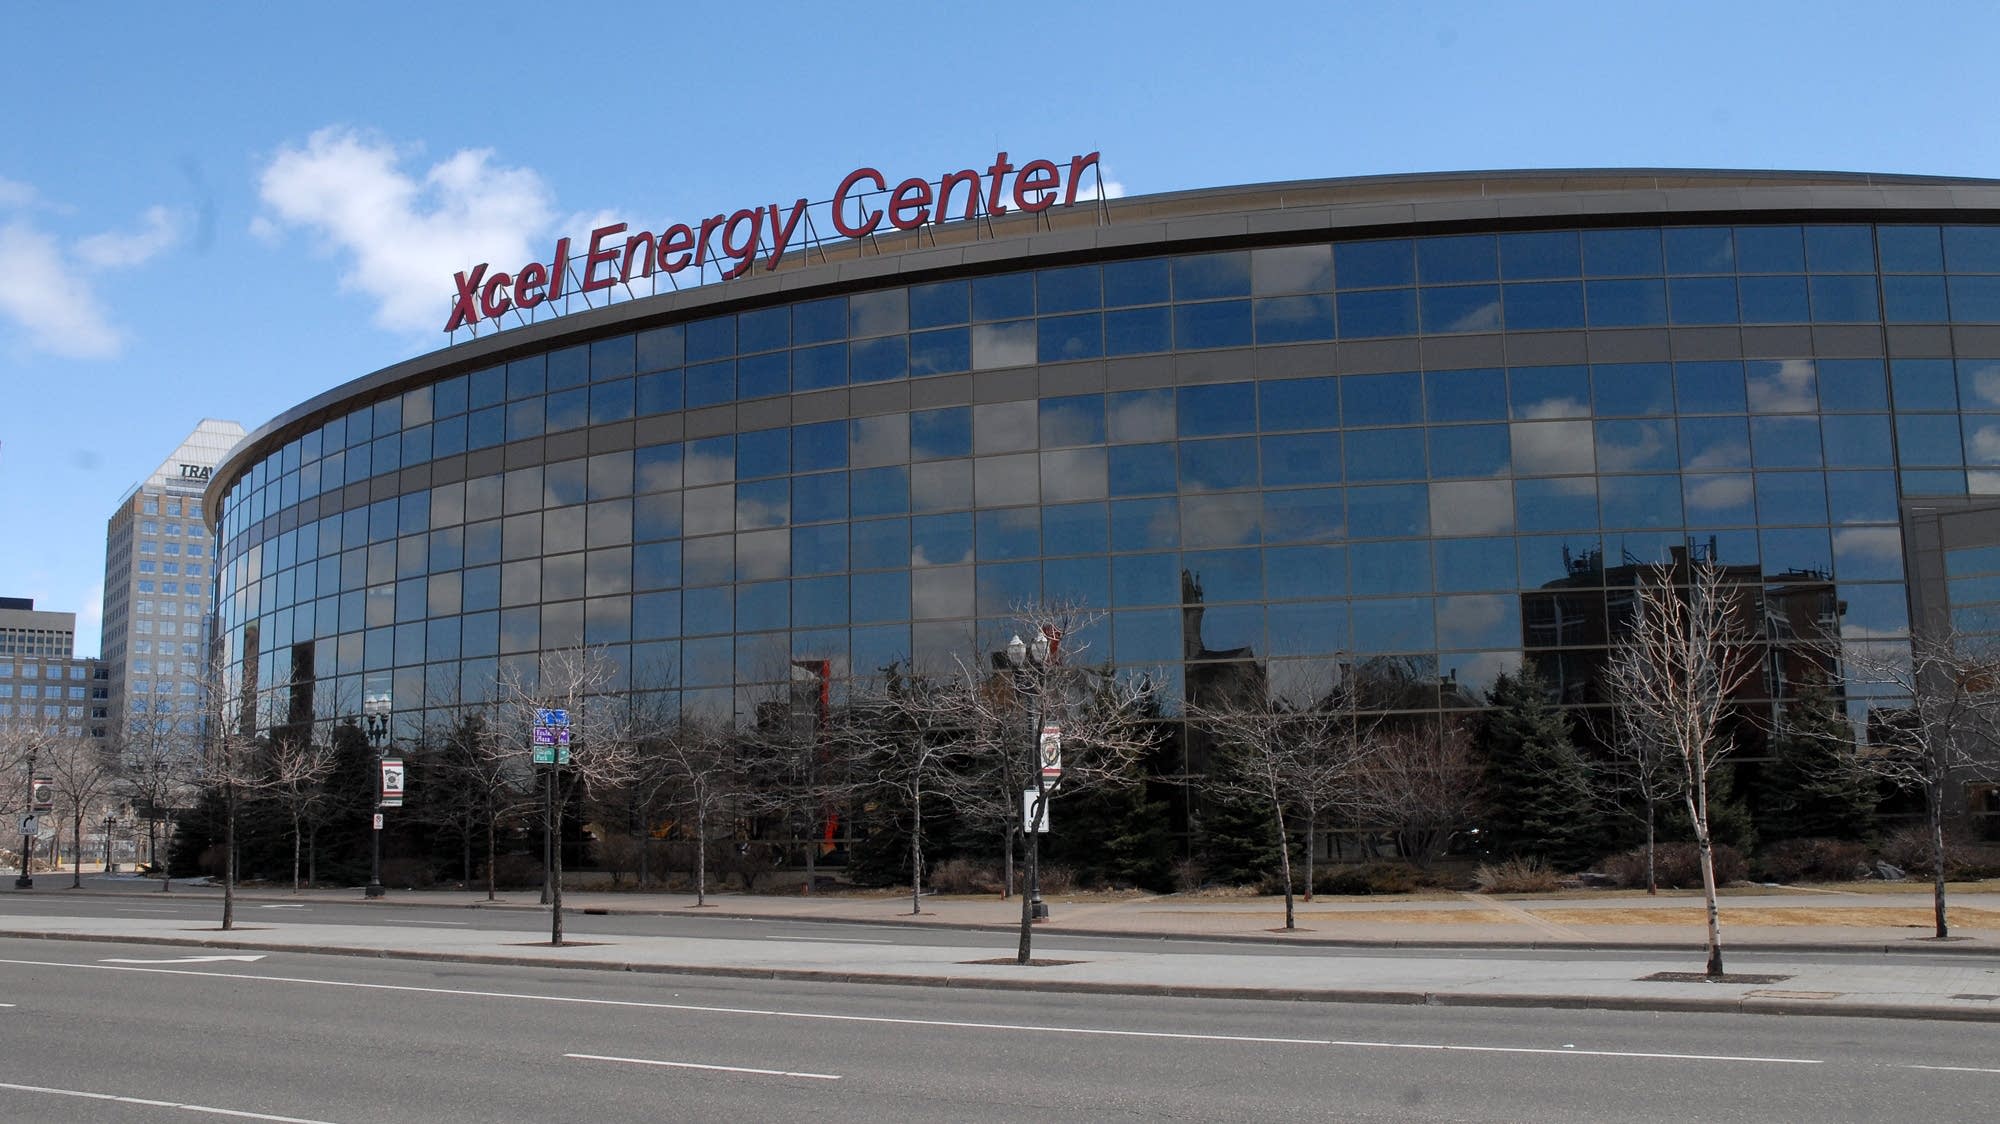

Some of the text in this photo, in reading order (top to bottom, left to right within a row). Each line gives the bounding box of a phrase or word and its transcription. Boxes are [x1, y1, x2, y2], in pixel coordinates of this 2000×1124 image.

[444, 152, 1100, 331] Xcel Energy Center
[1028, 819, 1045, 828] OY
